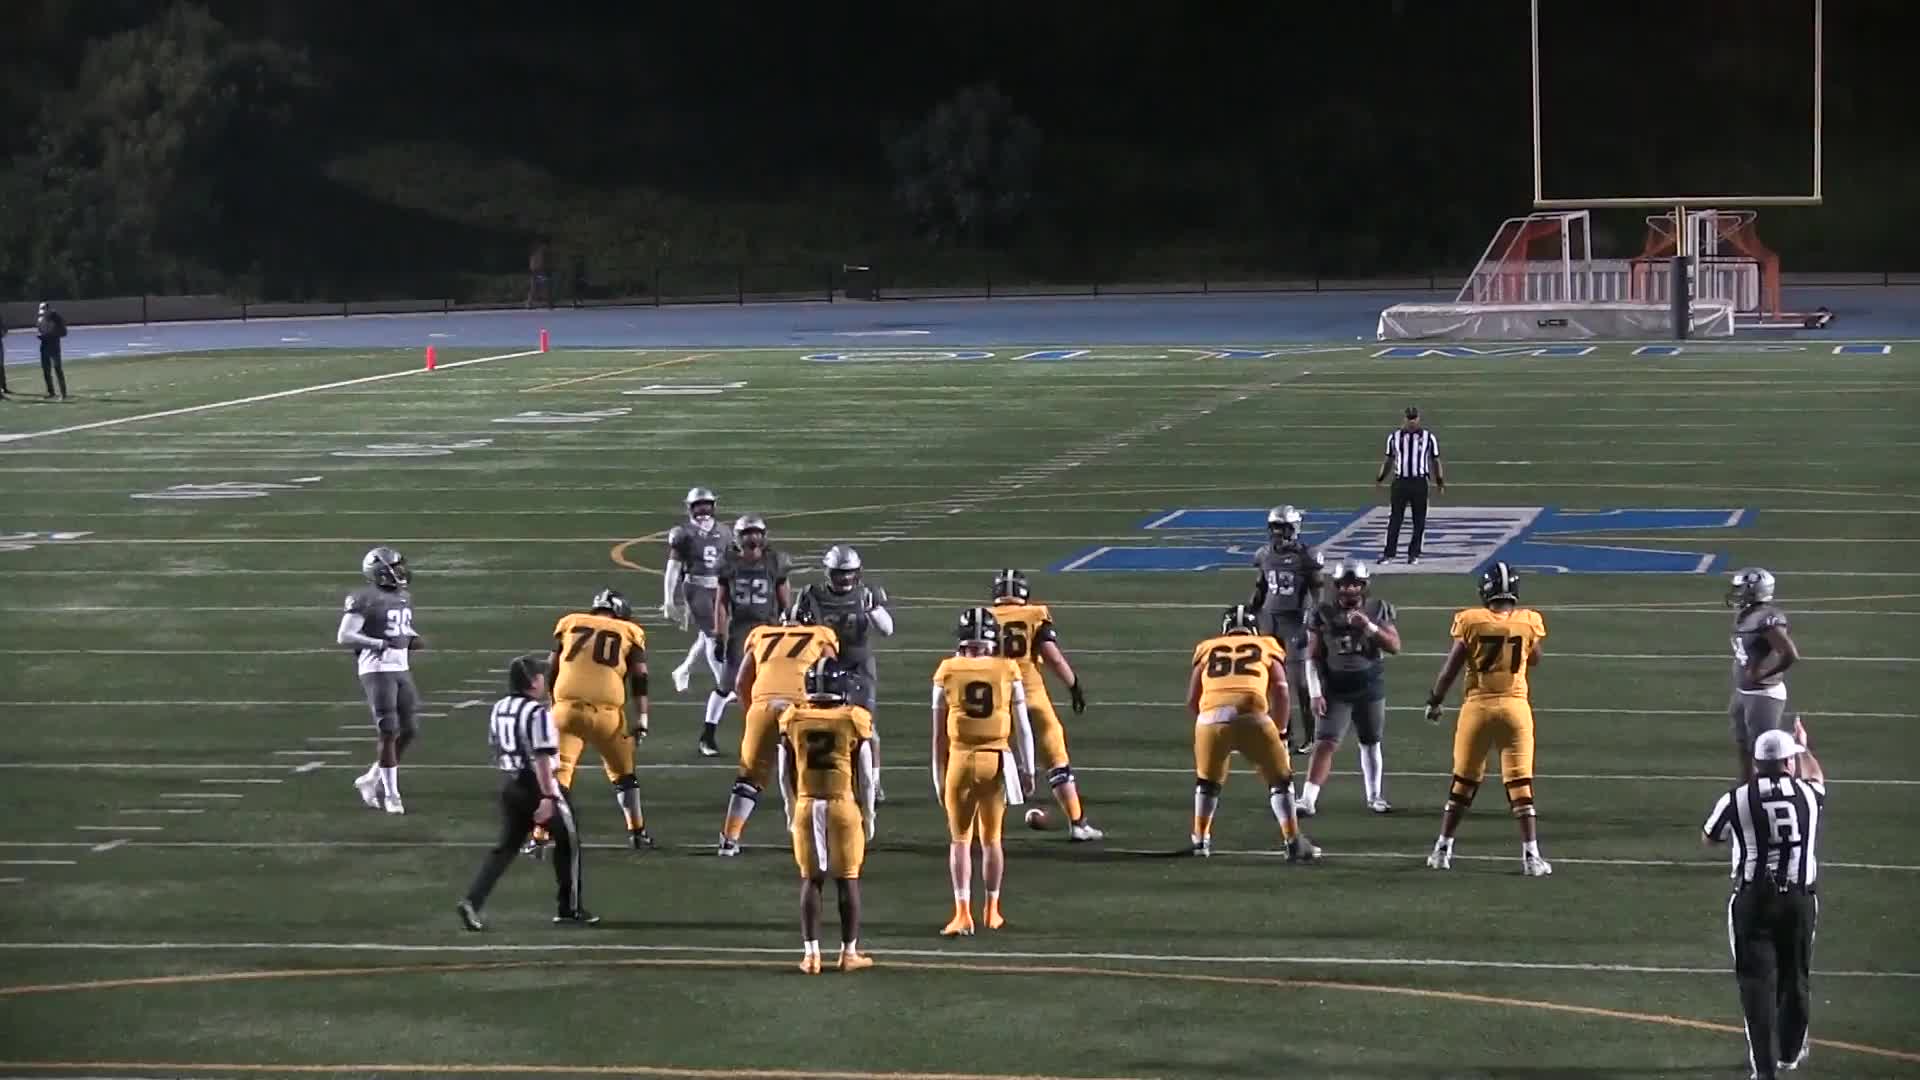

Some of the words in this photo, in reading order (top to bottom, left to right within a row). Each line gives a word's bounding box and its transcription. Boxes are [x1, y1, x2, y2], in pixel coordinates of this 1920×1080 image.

[735, 578, 769, 605] 52
[564, 626, 622, 667] 70
[760, 632, 815, 664] 77
[1003, 621, 1028, 658] 6
[1474, 635, 1523, 674] 71
[1207, 643, 1263, 678] 62
[963, 680, 993, 718] 9
[805, 730, 836, 769] 2
[1762, 800, 1802, 844] R
